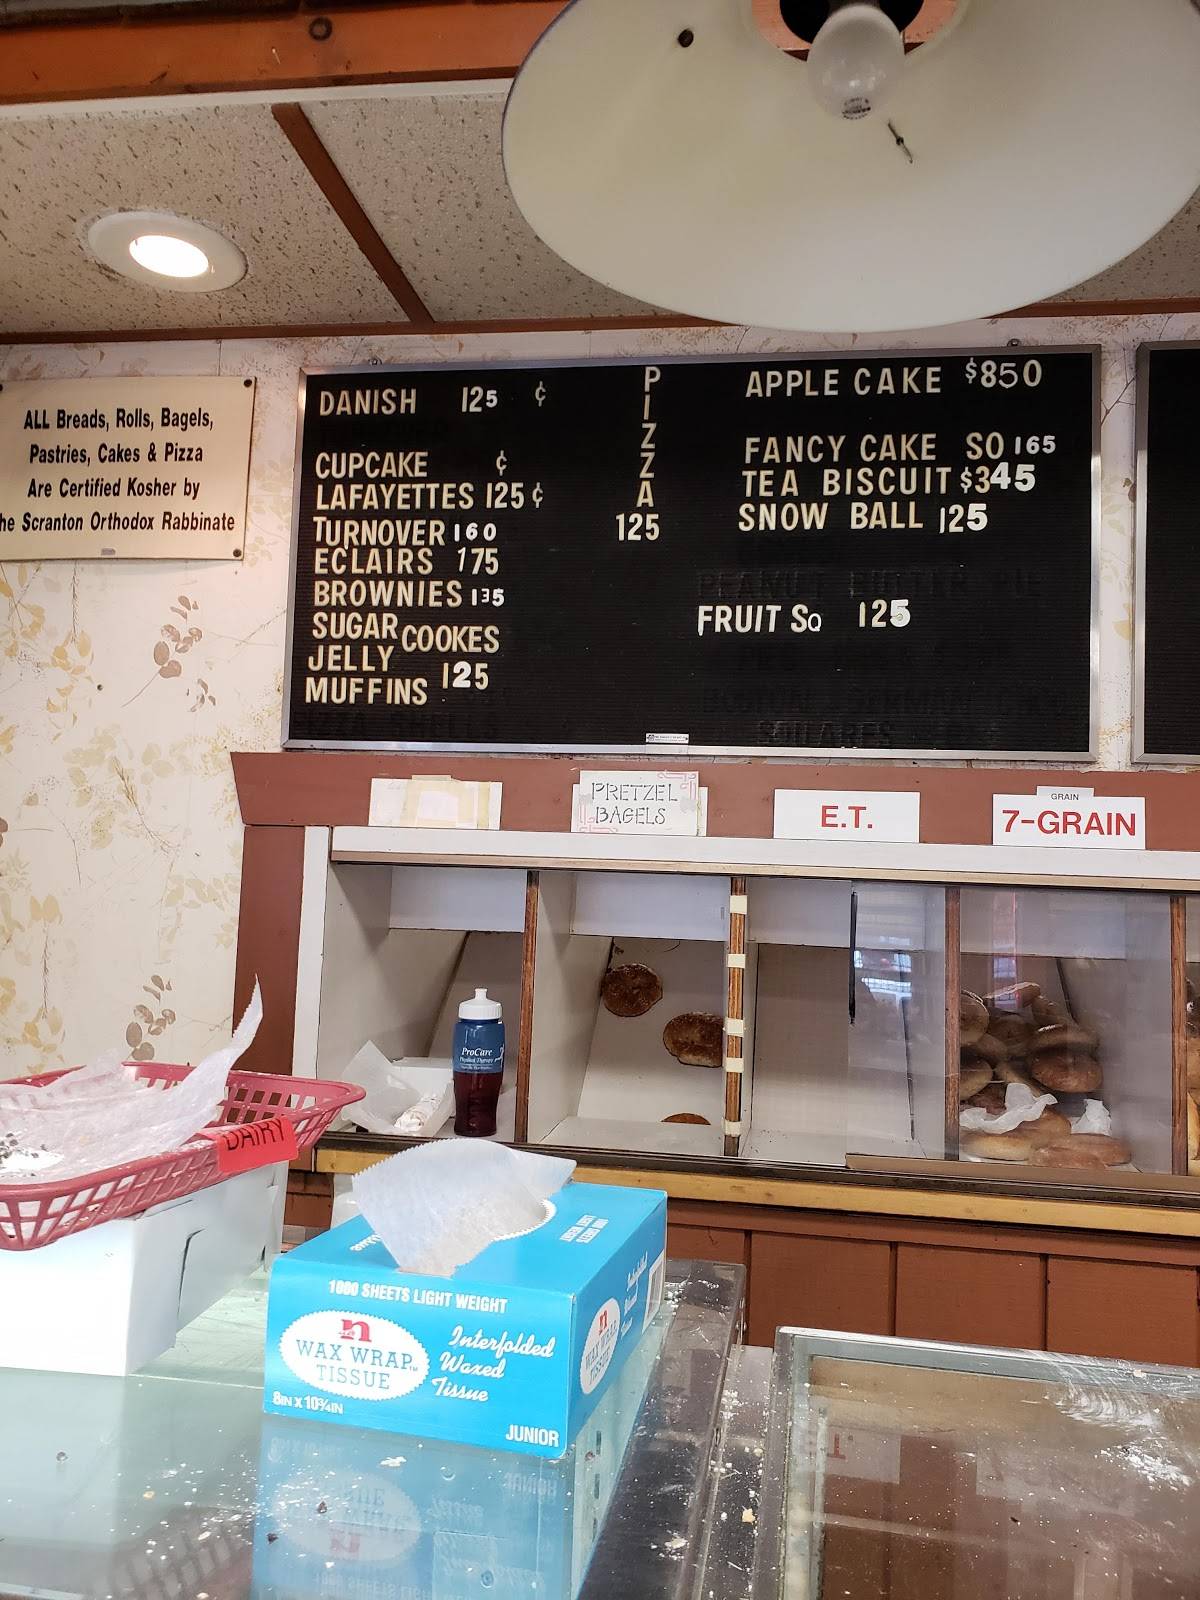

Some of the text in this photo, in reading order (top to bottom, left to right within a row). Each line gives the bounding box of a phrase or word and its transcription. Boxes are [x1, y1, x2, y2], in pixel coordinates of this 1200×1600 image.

[745, 357, 1042, 398] APPLE CAKE $850
[319, 388, 417, 416] DANISH
[462, 386, 497, 412] 125
[24, 407, 214, 432] ALL Breads, Rolls, Bagels,
[29, 442, 203, 466] Pastries, Cakes & Pizza
[744, 434, 846, 464] FANCY
[860, 433, 937, 461] CAKE
[1015, 435, 1056, 455] 165
[315, 451, 428, 478] CUPCAKE
[28, 477, 200, 500] Are Certified Kosher by
[742, 462, 1036, 497] TEA BISCUIT $345
[316, 482, 474, 511] LAFAYETTES
[485, 482, 524, 510] 125
[0, 511, 235, 532] he Scranton Orthodox Rabbinate
[615, 513, 660, 541] 125
[738, 501, 988, 533] SNOW BALL 125
[313, 516, 497, 549] TURNOVER 160
[313, 546, 499, 575] ECLAIRS 175
[314, 579, 505, 607] BROWNIES 135
[698, 605, 782, 636] FRUIT
[859, 599, 911, 628] 125
[312, 612, 500, 654] SUGAR COOKES
[308, 645, 394, 672] JELLY
[305, 661, 489, 705] MUFFINS 125
[591, 782, 679, 802] PRETZEL
[1051, 793, 1080, 801] GRAIN
[595, 805, 666, 825] BAGELS
[821, 804, 873, 829] E.T.
[1002, 809, 1136, 837] 7-GRAIN
[461, 1047, 493, 1057] ProCare
[223, 1120, 286, 1151] DAIRY
[328, 1279, 508, 1314] 1000 SHEETS LIGHT WEIGHT
[296, 1339, 342, 1362] WAX
[350, 1346, 413, 1371] WRAP
[448, 1325, 556, 1359] Interfolded
[316, 1364, 390, 1390] TISSUE
[440, 1351, 506, 1378] Waxed
[431, 1376, 489, 1401] Tissue
[505, 1424, 560, 1448] JUNIOR
